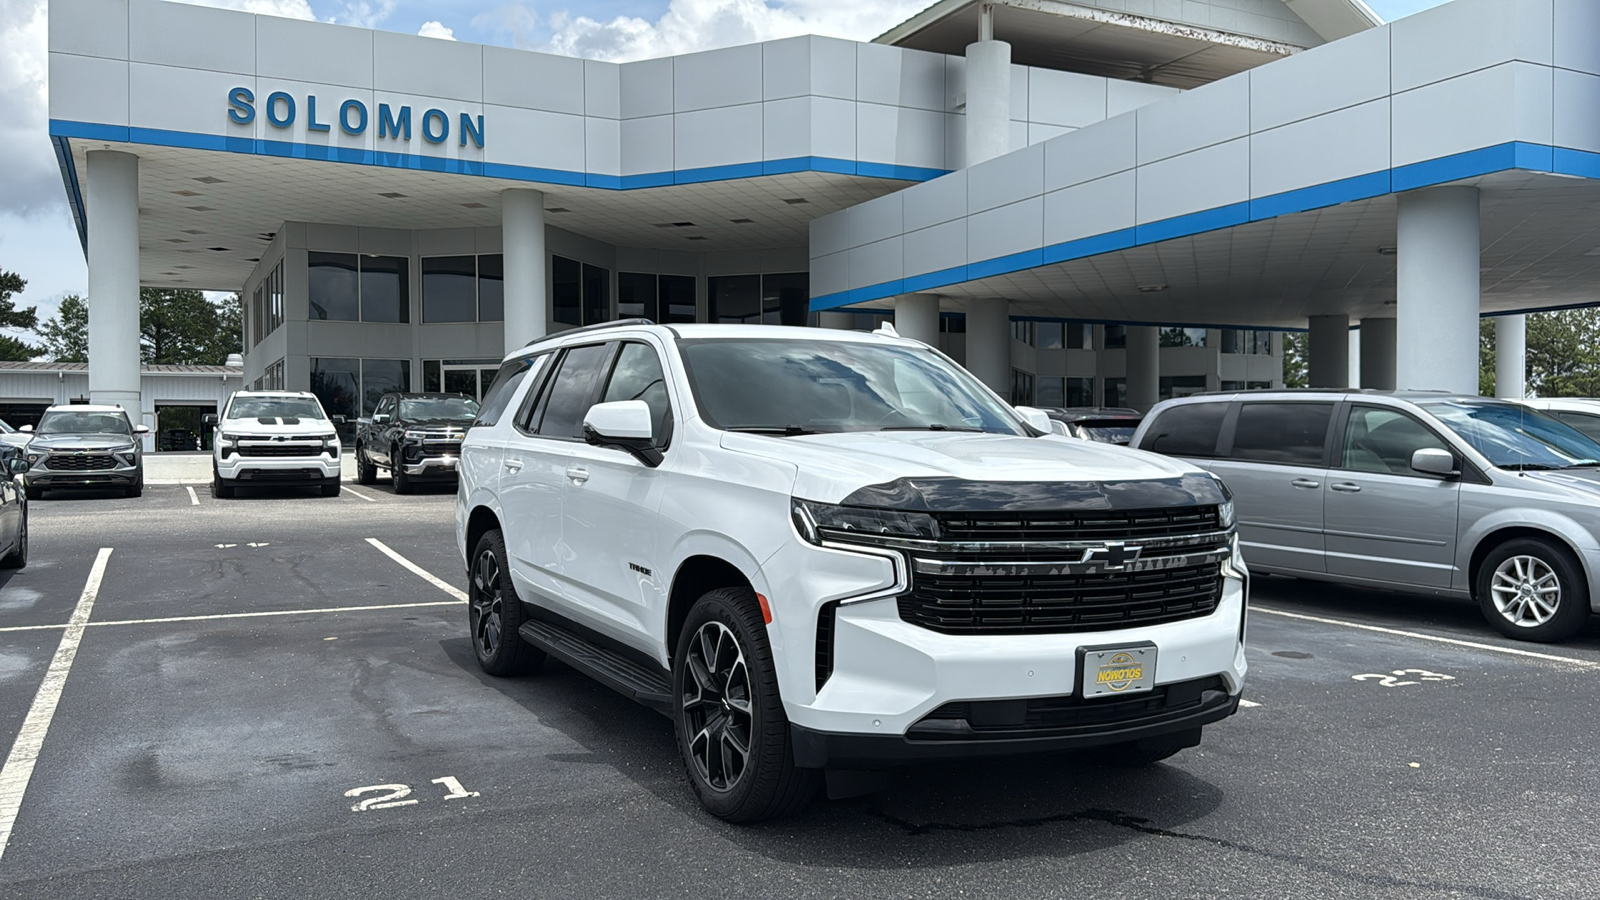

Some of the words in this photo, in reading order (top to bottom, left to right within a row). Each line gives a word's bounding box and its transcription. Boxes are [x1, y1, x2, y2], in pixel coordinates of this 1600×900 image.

[227, 87, 485, 148] SOLOMON
[1098, 667, 1142, 682] SOLOMON
[344, 775, 481, 812] 21
